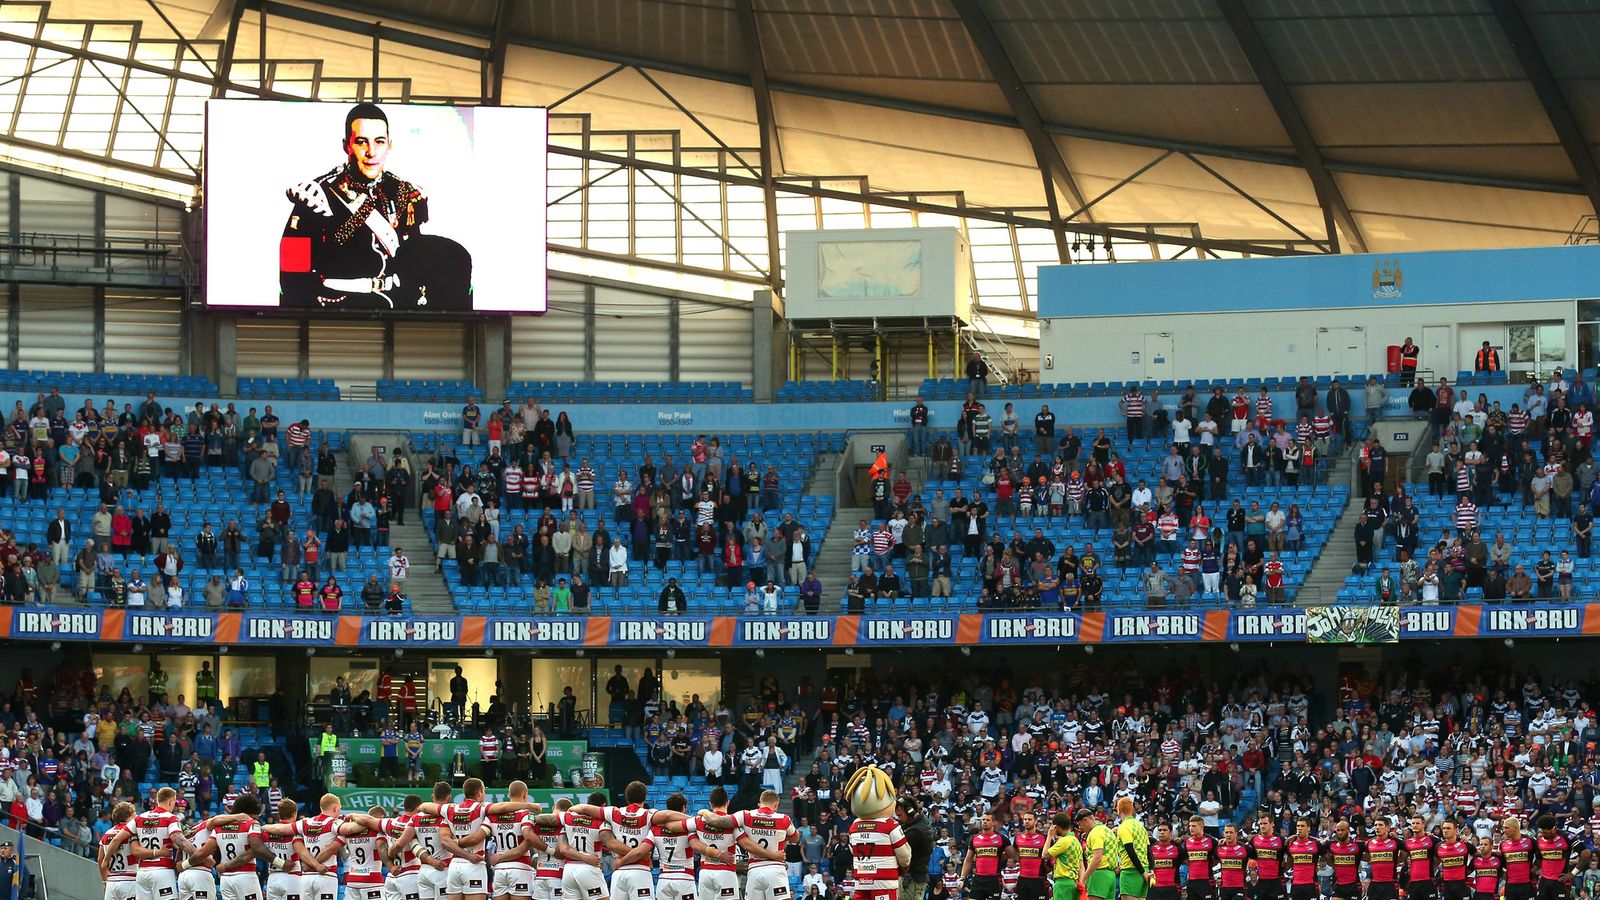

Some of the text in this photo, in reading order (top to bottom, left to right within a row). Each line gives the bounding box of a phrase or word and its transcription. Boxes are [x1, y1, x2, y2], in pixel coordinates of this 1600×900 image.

[674, 411, 691, 419] Paul
[1281, 615, 1307, 634] BR
[583, 761, 597, 769] BIG
[141, 837, 160, 850] 26
[424, 837, 435, 855] 5
[498, 832, 517, 849] 10
[574, 836, 587, 852] 11
[225, 843, 237, 860] 8
[355, 847, 366, 865] 9
[664, 847, 676, 863] 7
[109, 853, 125, 870] 23
